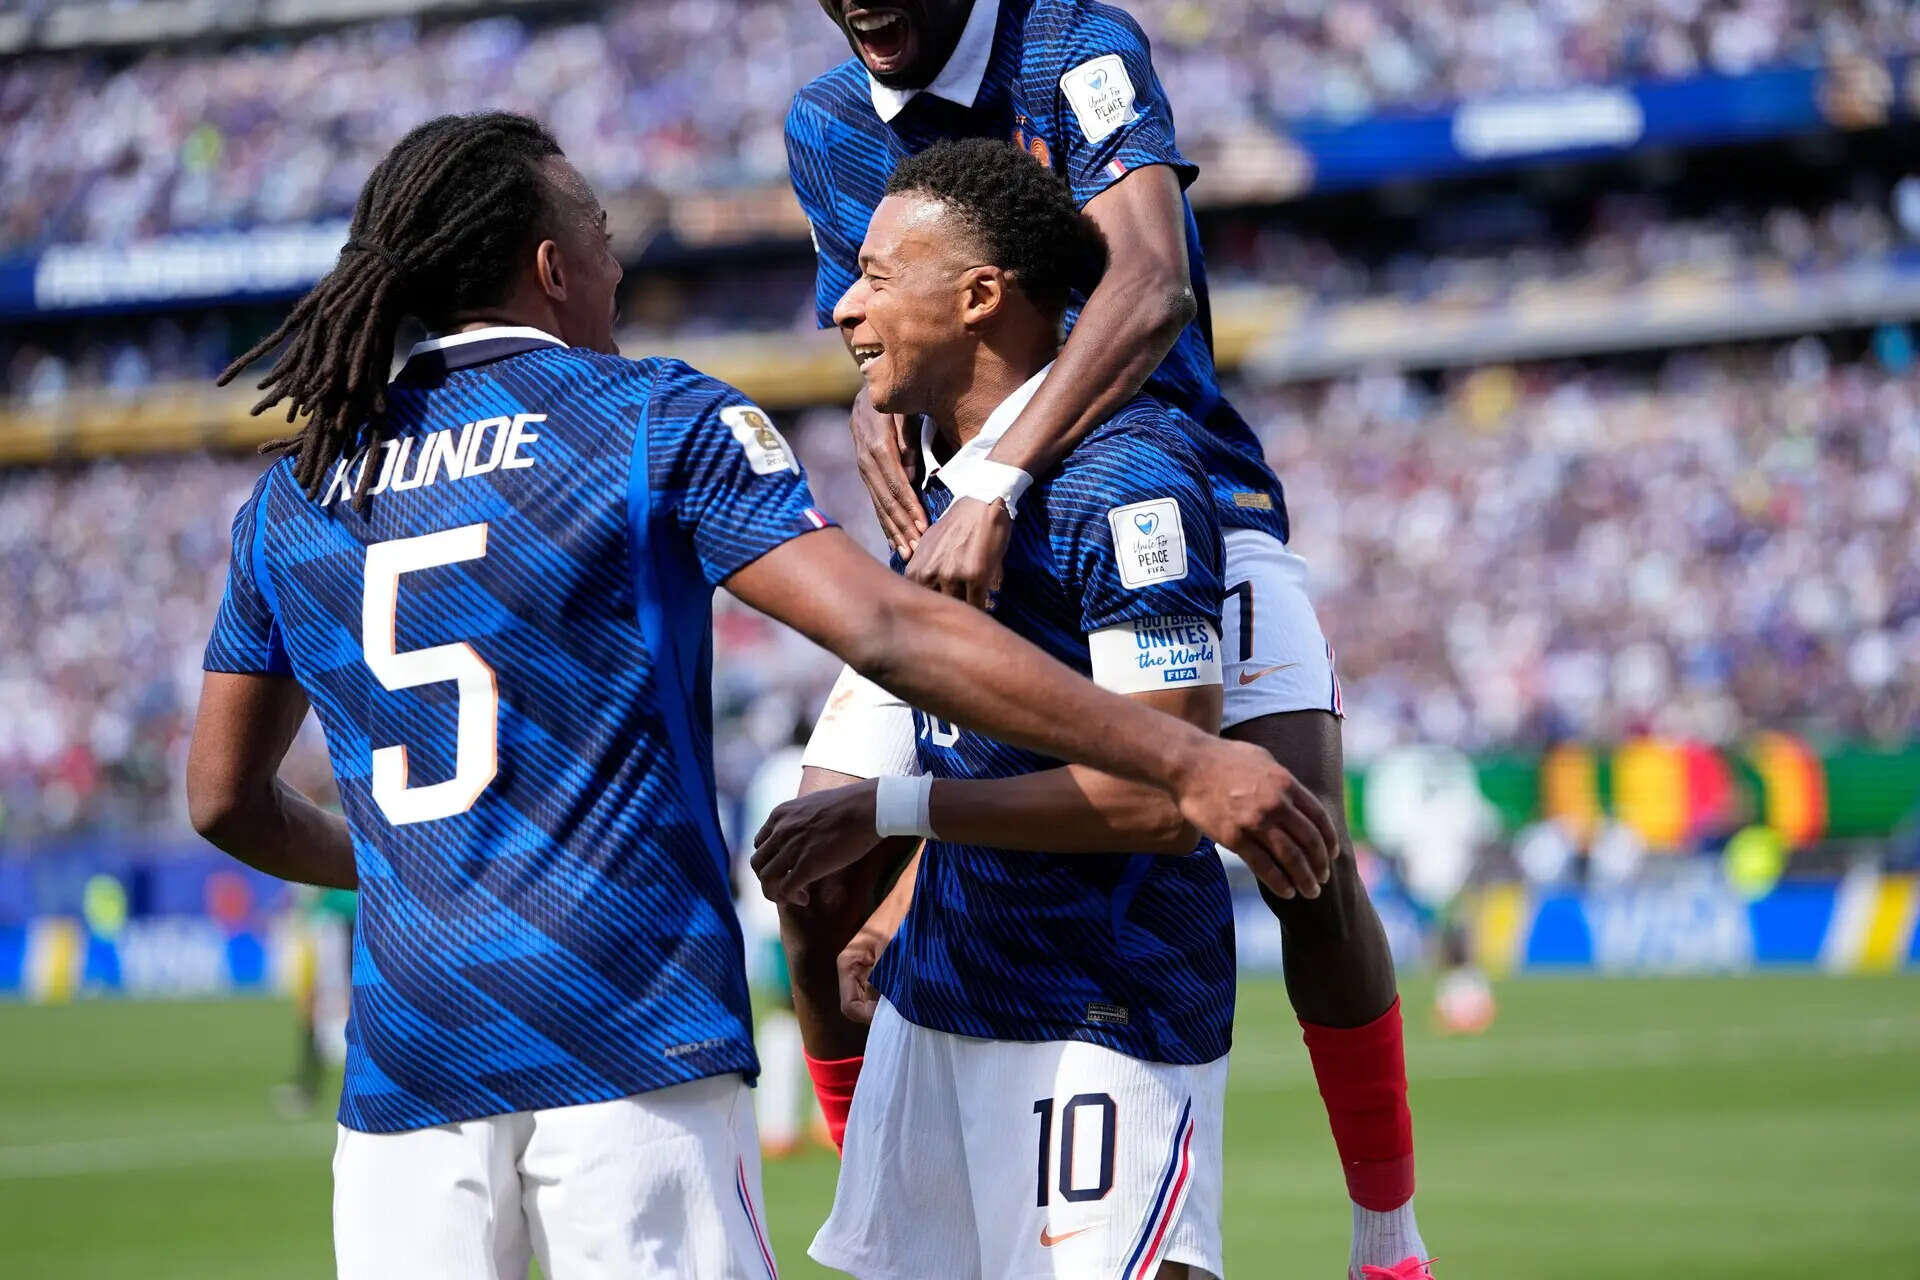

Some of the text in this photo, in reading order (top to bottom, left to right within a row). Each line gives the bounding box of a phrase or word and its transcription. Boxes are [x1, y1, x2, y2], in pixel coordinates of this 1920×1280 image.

[1095, 97, 1126, 120] PEACE
[1132, 534, 1169, 554] Unite For
[1138, 549, 1169, 567] PEACE
[1147, 565, 1165, 574] FIFA
[1135, 624, 1209, 649] UNITES
[1134, 644, 1214, 669] the World
[362, 522, 499, 826] 5
[1166, 669, 1196, 681] FIFA
[1033, 1092, 1117, 1207] 10
